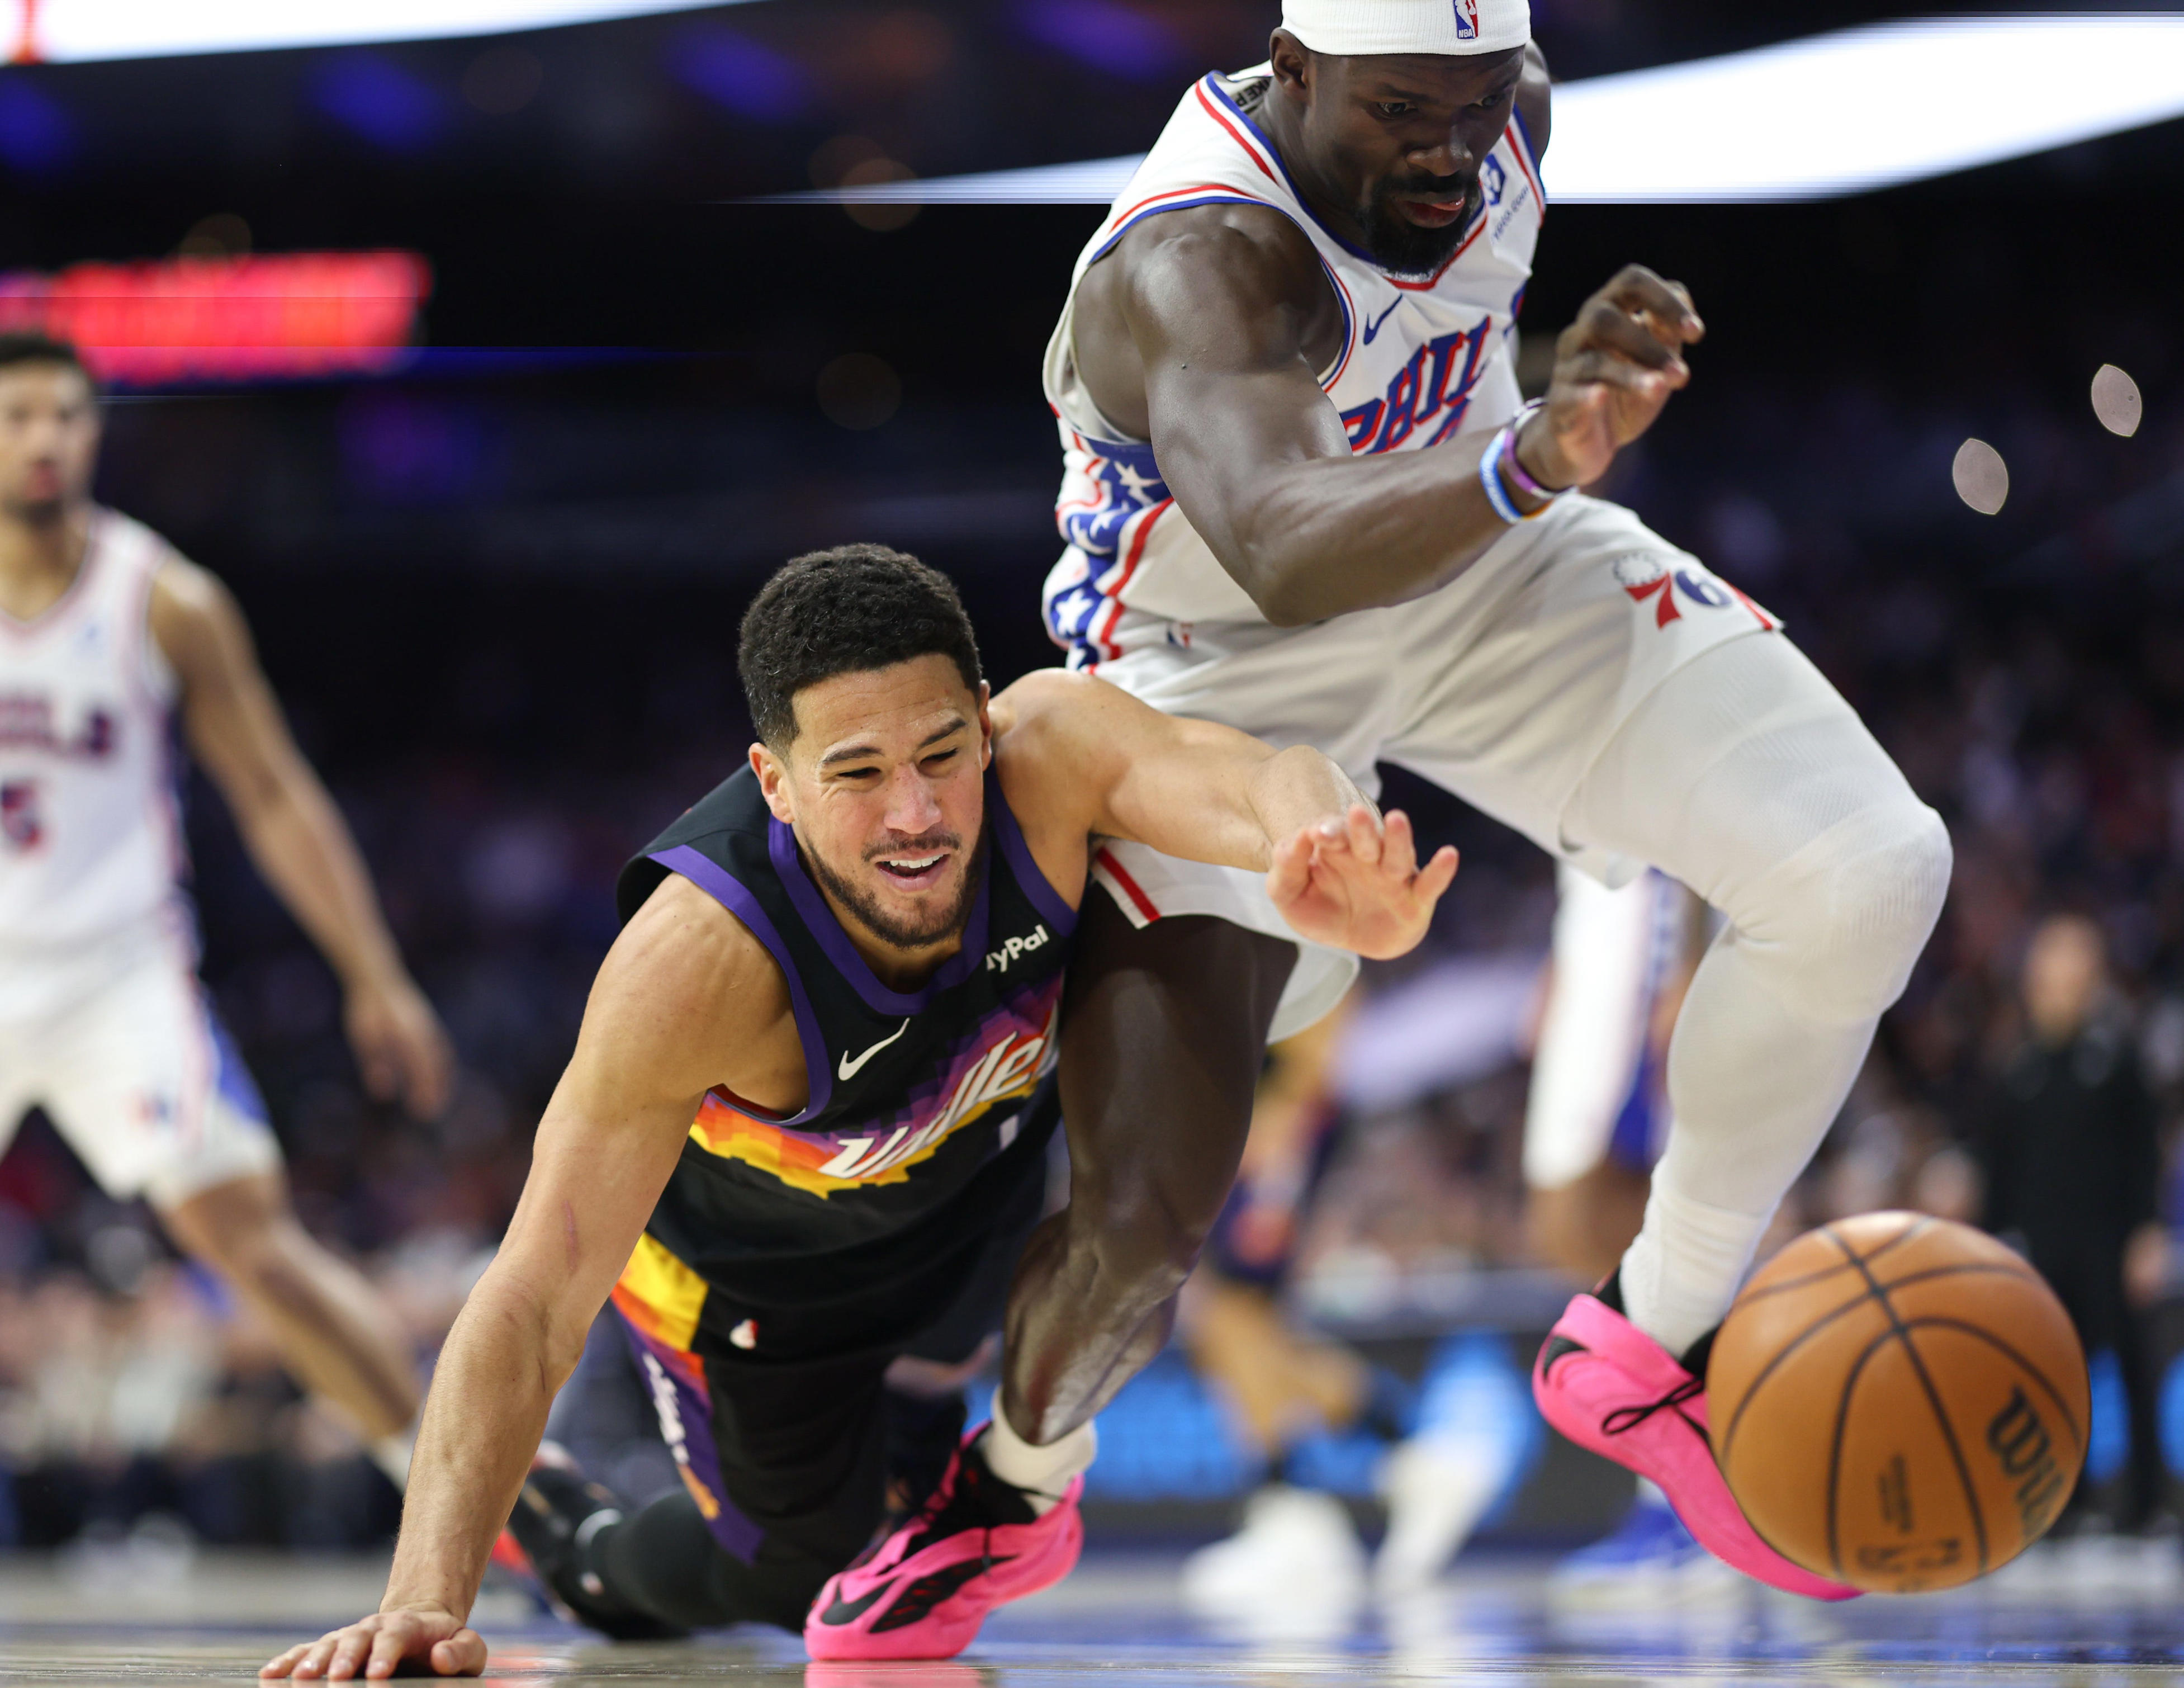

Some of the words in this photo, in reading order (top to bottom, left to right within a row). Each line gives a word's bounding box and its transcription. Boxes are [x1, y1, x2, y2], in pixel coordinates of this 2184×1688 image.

[1458, 29, 1473, 38] NBA
[1339, 314, 1494, 455] PHIL
[986, 924, 1049, 972] yPal
